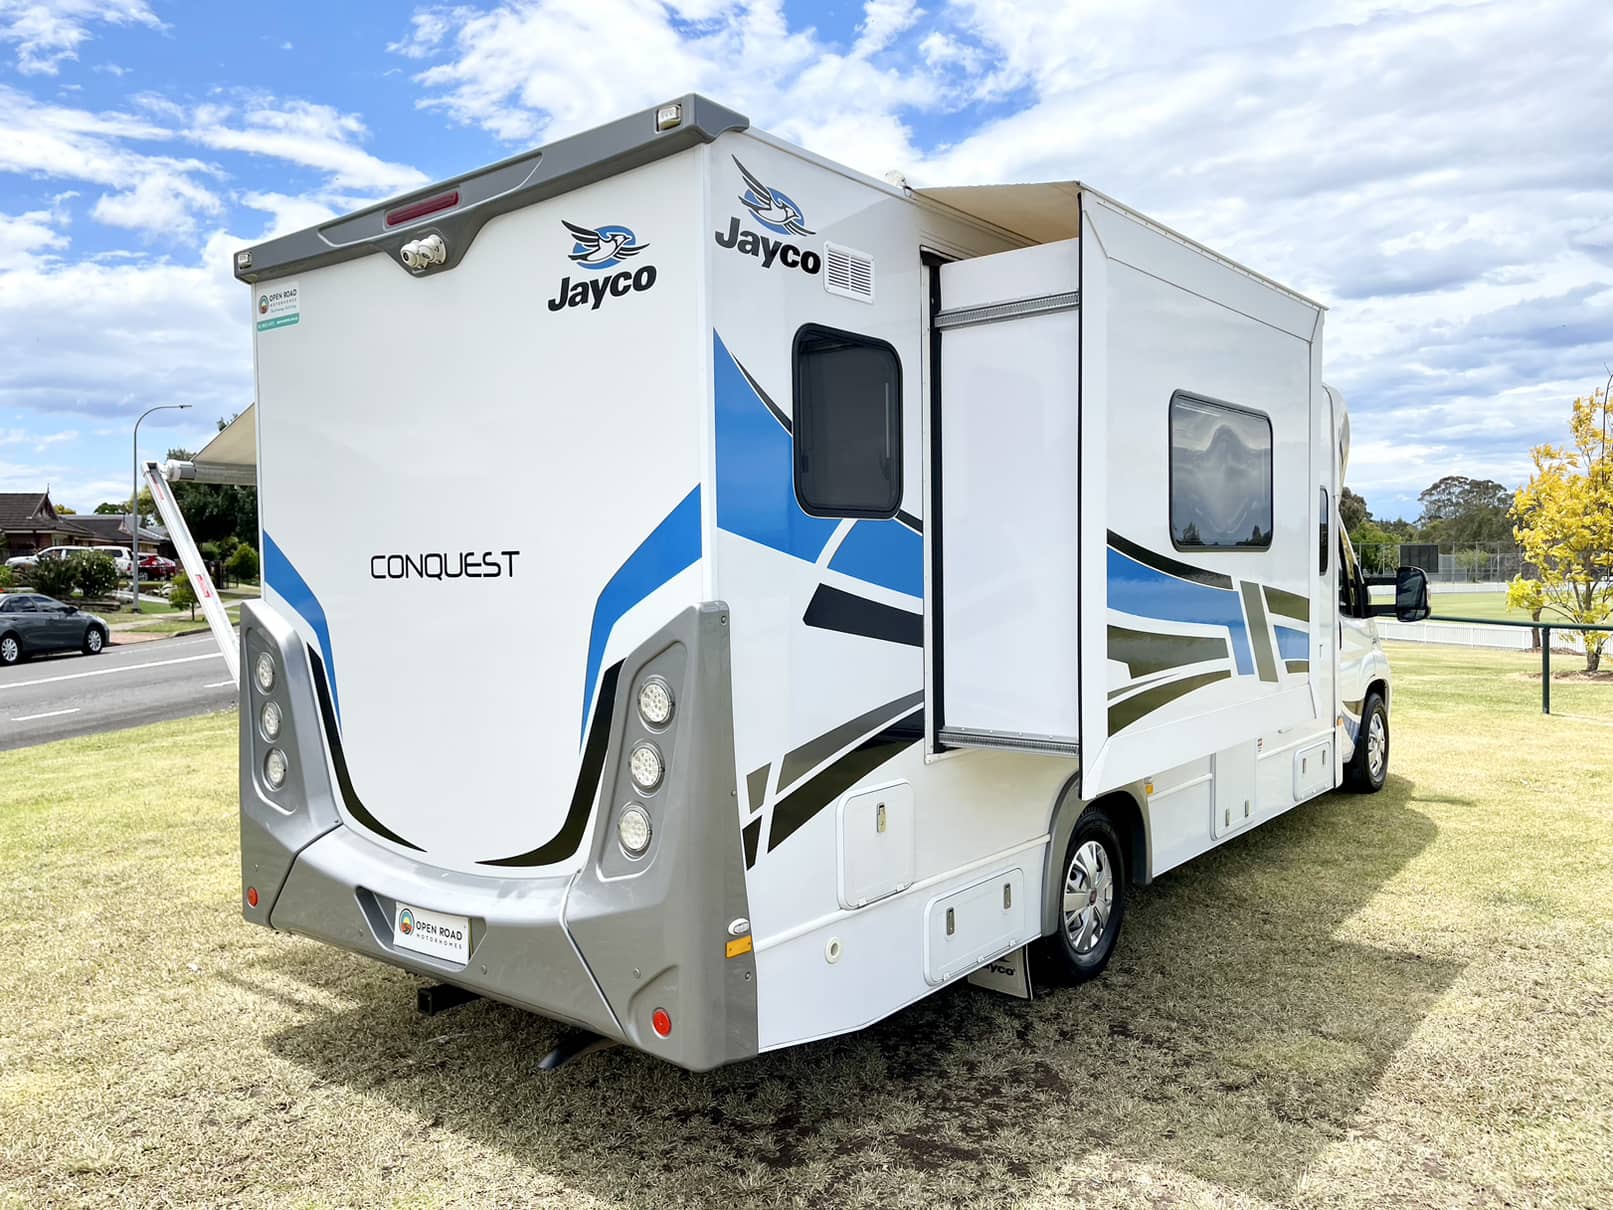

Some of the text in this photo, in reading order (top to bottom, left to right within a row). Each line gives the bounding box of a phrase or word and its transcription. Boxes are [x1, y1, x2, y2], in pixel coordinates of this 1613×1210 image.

[715, 216, 821, 275] Jayco
[269, 293, 282, 302] OPEN
[284, 289, 297, 299] ROAD
[548, 265, 657, 312] Jayco
[370, 551, 520, 581] CONQUEST
[416, 921, 463, 941] OPEN ROAD
